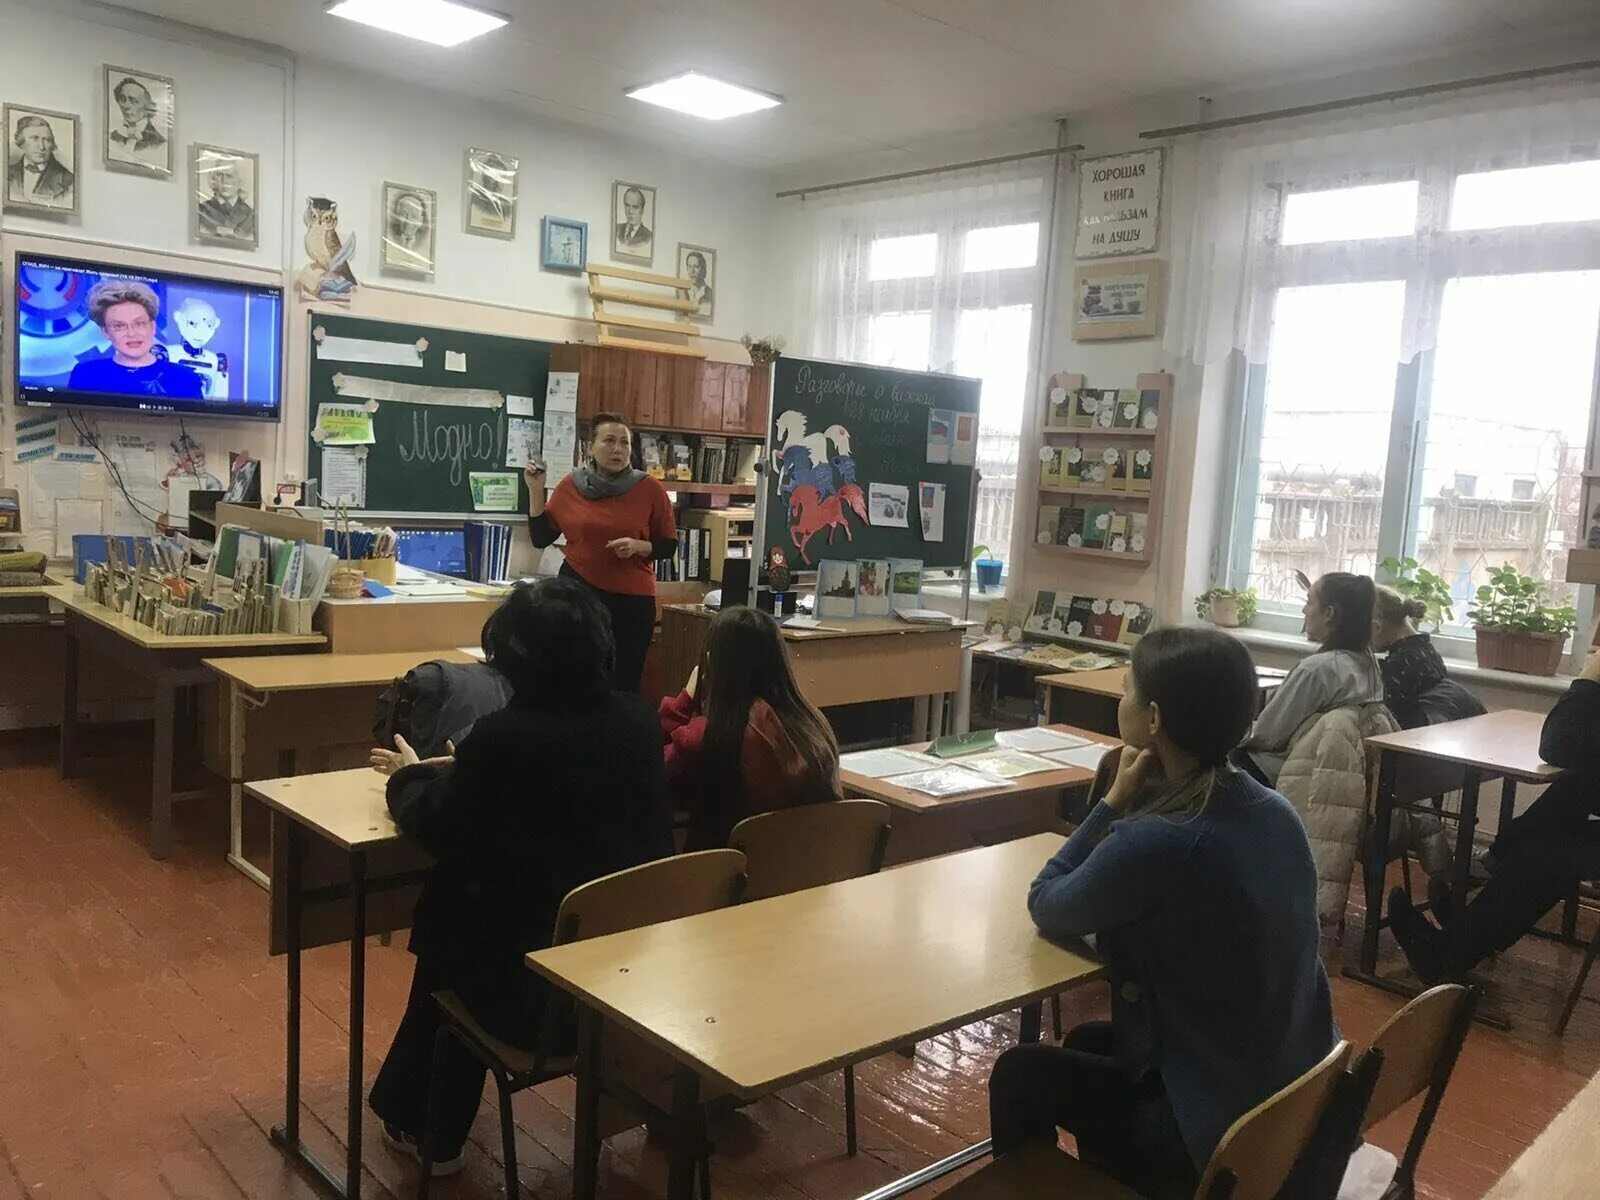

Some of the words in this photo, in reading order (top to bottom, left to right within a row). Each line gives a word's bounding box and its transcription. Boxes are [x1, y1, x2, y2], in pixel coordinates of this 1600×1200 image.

[1092, 164, 1145, 183] ХОРОШАЯ
[1104, 187, 1134, 202] КНИГА
[1092, 233, 1104, 245] НА
[1109, 229, 1141, 244] ДУШУ
[795, 366, 866, 410] Разговоры
[399, 410, 504, 486] Модно!
